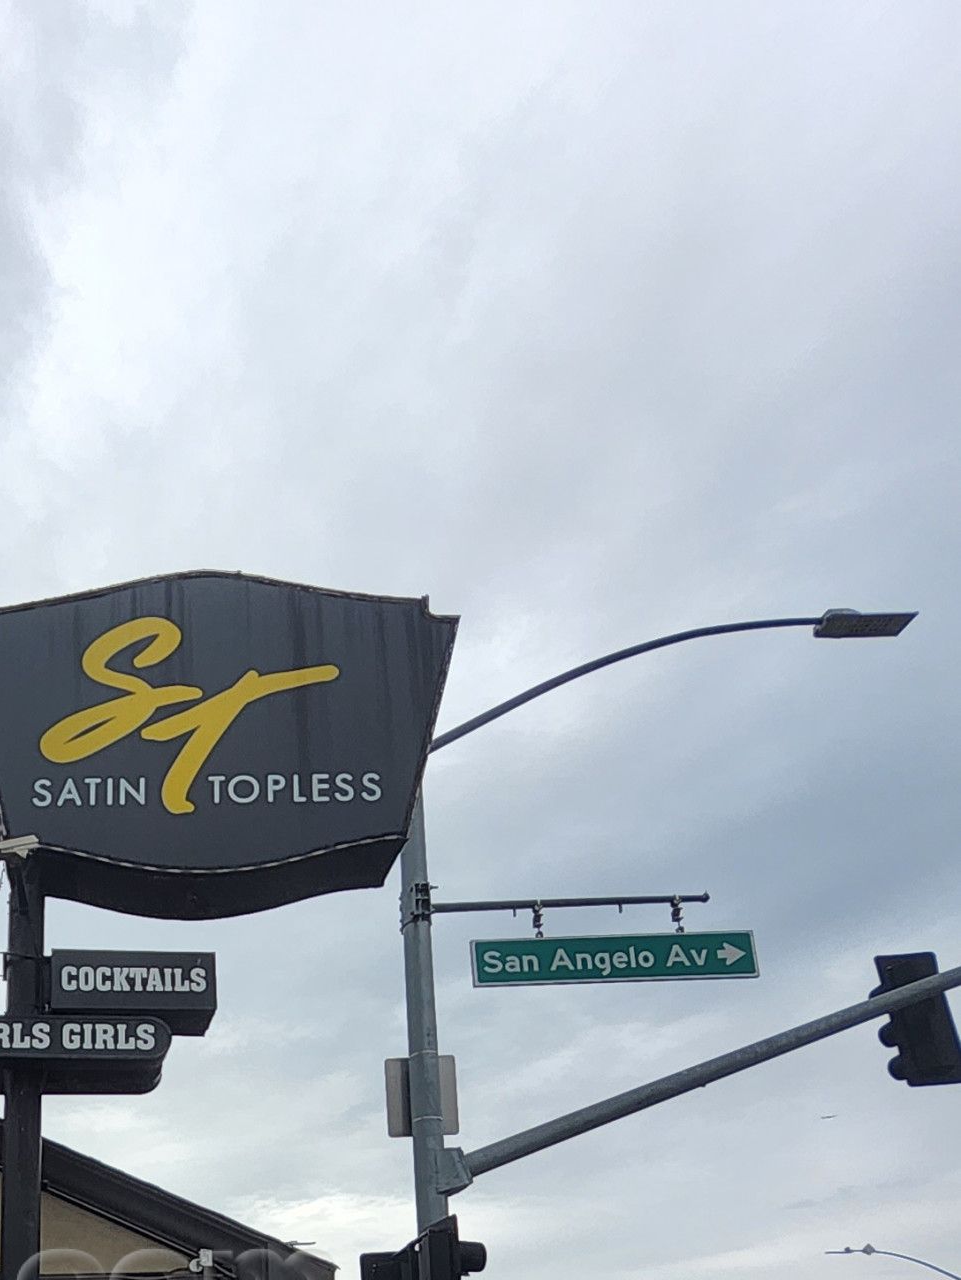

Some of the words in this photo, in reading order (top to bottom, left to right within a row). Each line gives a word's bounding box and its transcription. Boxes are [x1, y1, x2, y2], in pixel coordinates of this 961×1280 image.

[32, 777, 146, 807] SATIN
[207, 772, 382, 805] TOPLESS
[483, 951, 539, 973] San
[550, 946, 654, 976] Angelo
[666, 944, 708, 967] Av
[61, 966, 207, 993] COCKTAILS
[62, 1023, 156, 1051] GIRLS
